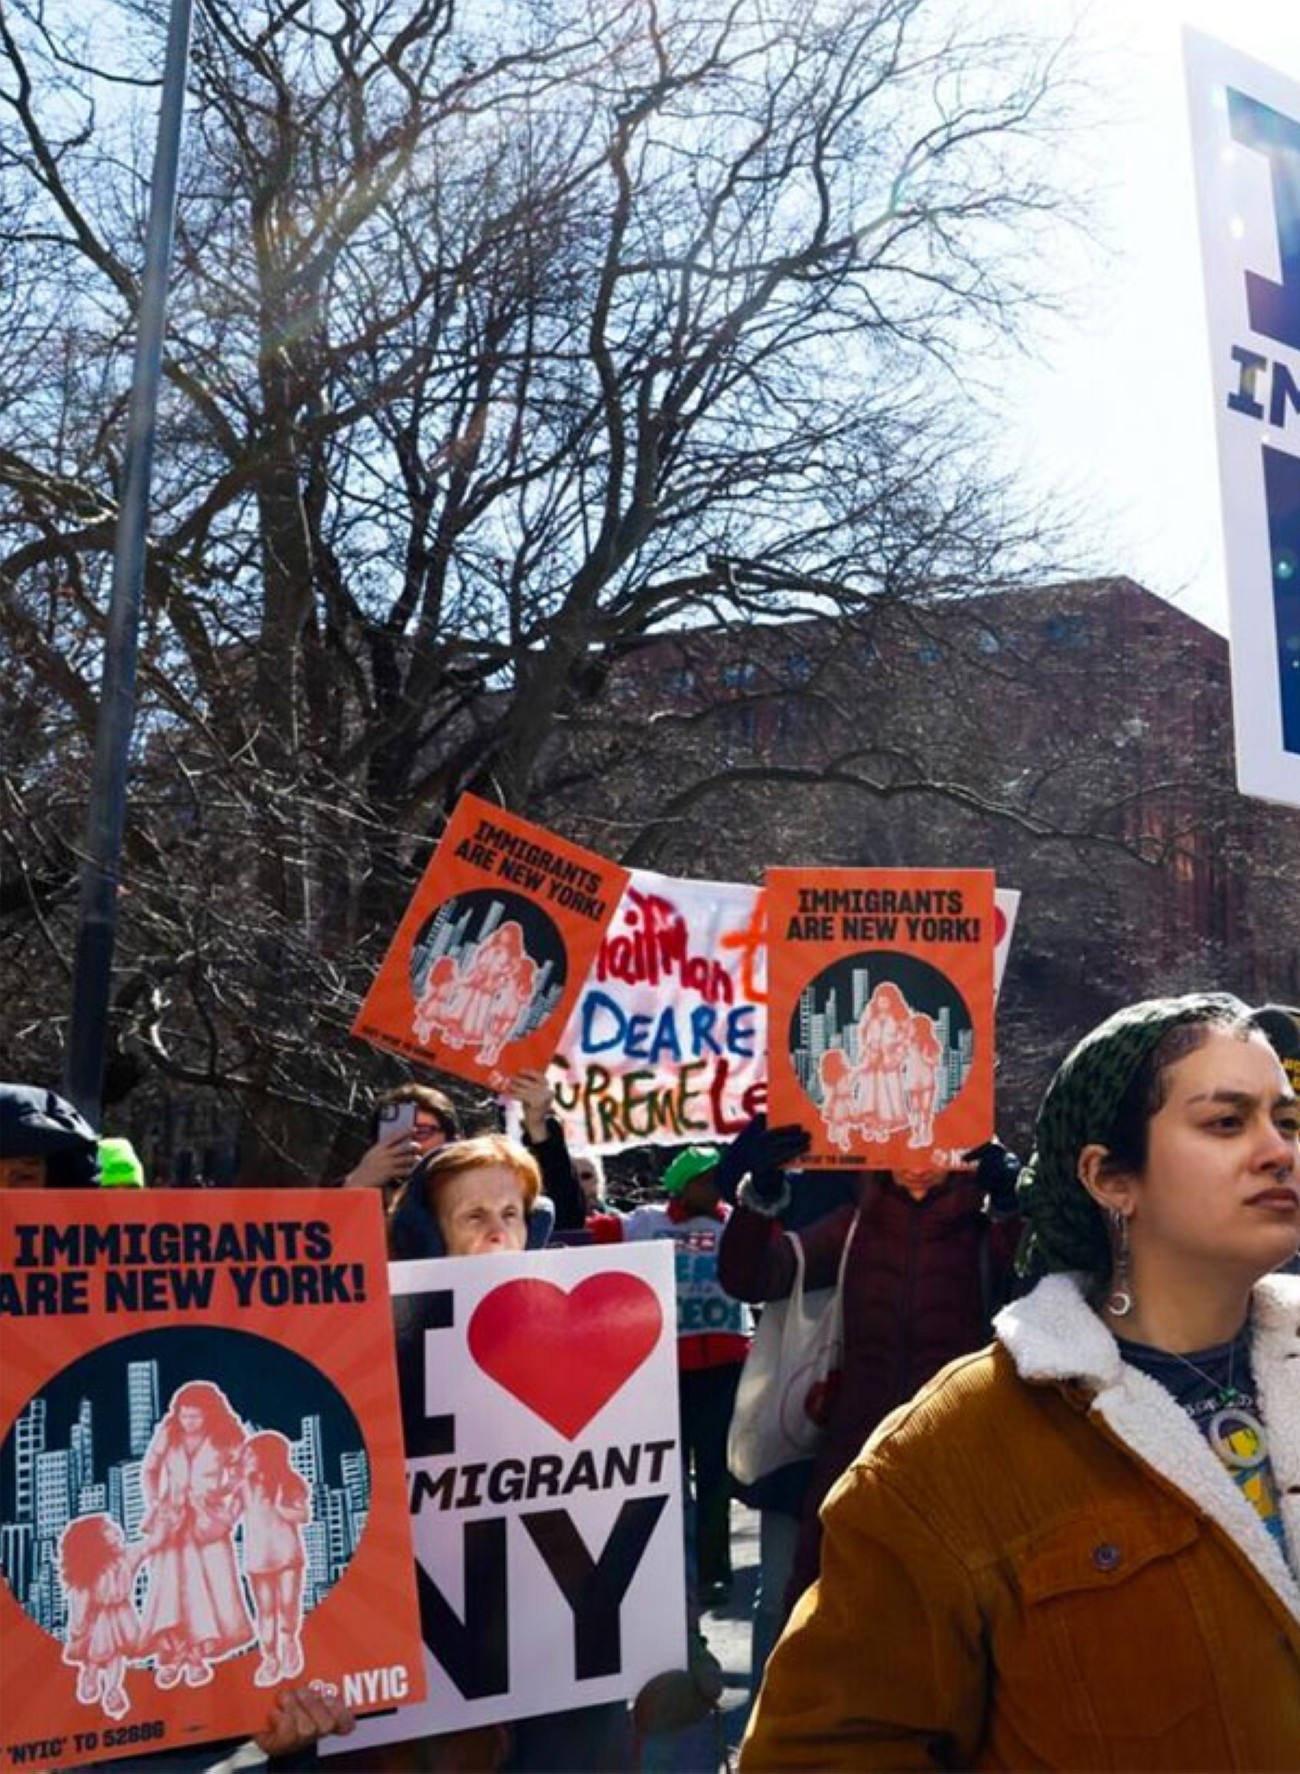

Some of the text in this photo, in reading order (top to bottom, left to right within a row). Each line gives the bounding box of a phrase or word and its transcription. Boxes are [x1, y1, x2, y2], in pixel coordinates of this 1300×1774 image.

[455, 838, 606, 921] ARE NEW YORK!
[474, 820, 603, 895] IMMIGRANTS
[797, 888, 963, 915] IMMIGRANTS
[787, 916, 980, 943] ARE NEW YORK!
[550, 1053, 708, 1144] UPREME
[15, 1221, 333, 1267] IMMIGRANTS
[0, 1263, 367, 1316] ARE NEW YORK!
[407, 1439, 676, 1515] MIGRANT
[343, 1665, 409, 1706] NYIC
[74, 1732, 98, 1753] TO
